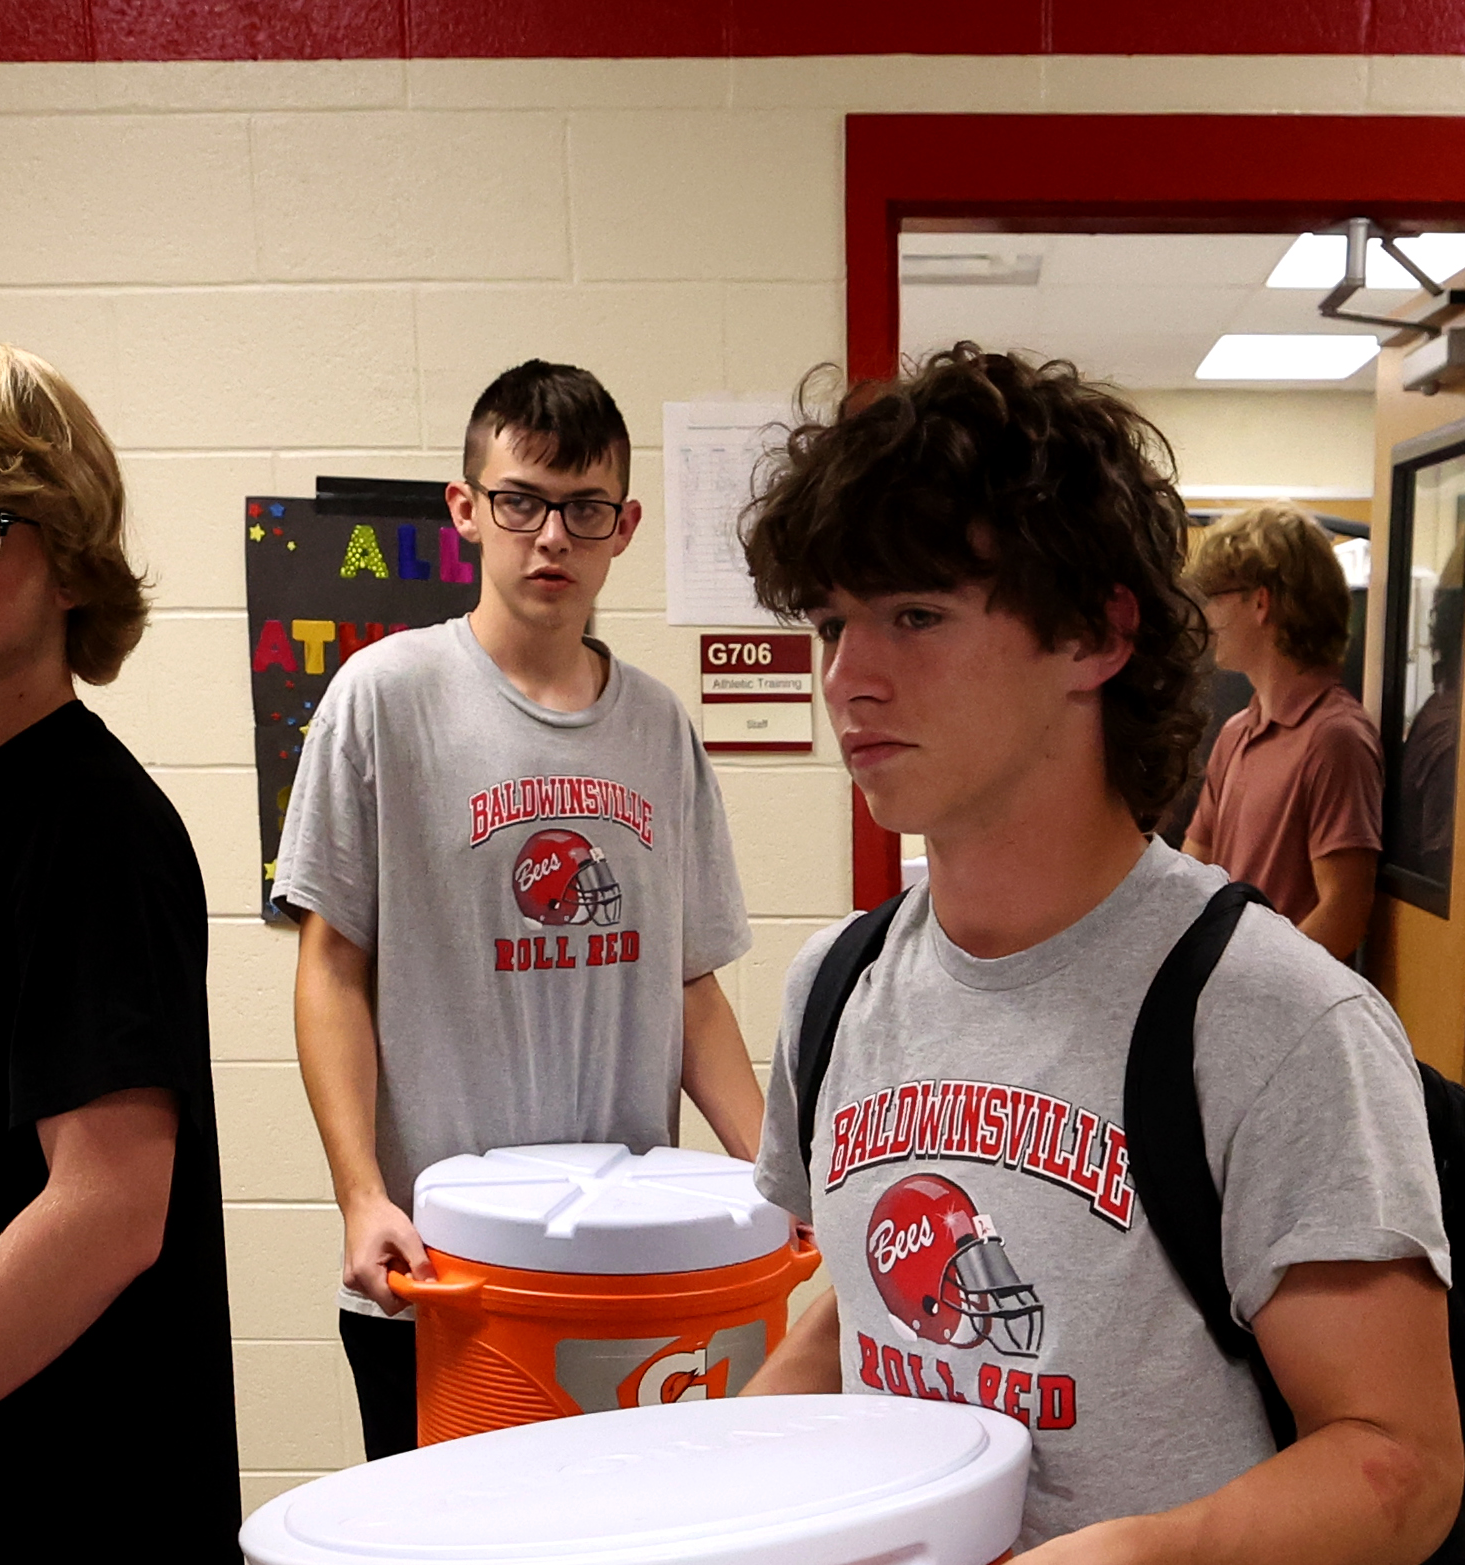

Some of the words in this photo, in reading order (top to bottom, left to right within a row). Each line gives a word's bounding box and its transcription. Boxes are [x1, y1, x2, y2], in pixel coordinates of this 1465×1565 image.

[339, 524, 474, 583] ALL
[252, 619, 410, 675] ATH
[707, 642, 772, 666] G706
[712, 678, 753, 690] Athletic
[757, 677, 802, 691] Training
[746, 719, 769, 730] Staff
[469, 775, 653, 850] BALDWINSVILLE
[514, 851, 562, 892] Bees
[494, 935, 577, 972] ROLL
[586, 930, 641, 967] RED
[825, 1079, 1136, 1233] BALDWINSVILLE
[869, 1214, 935, 1274] Bees
[857, 1330, 968, 1405] ROLL
[978, 1362, 1077, 1430] RED
